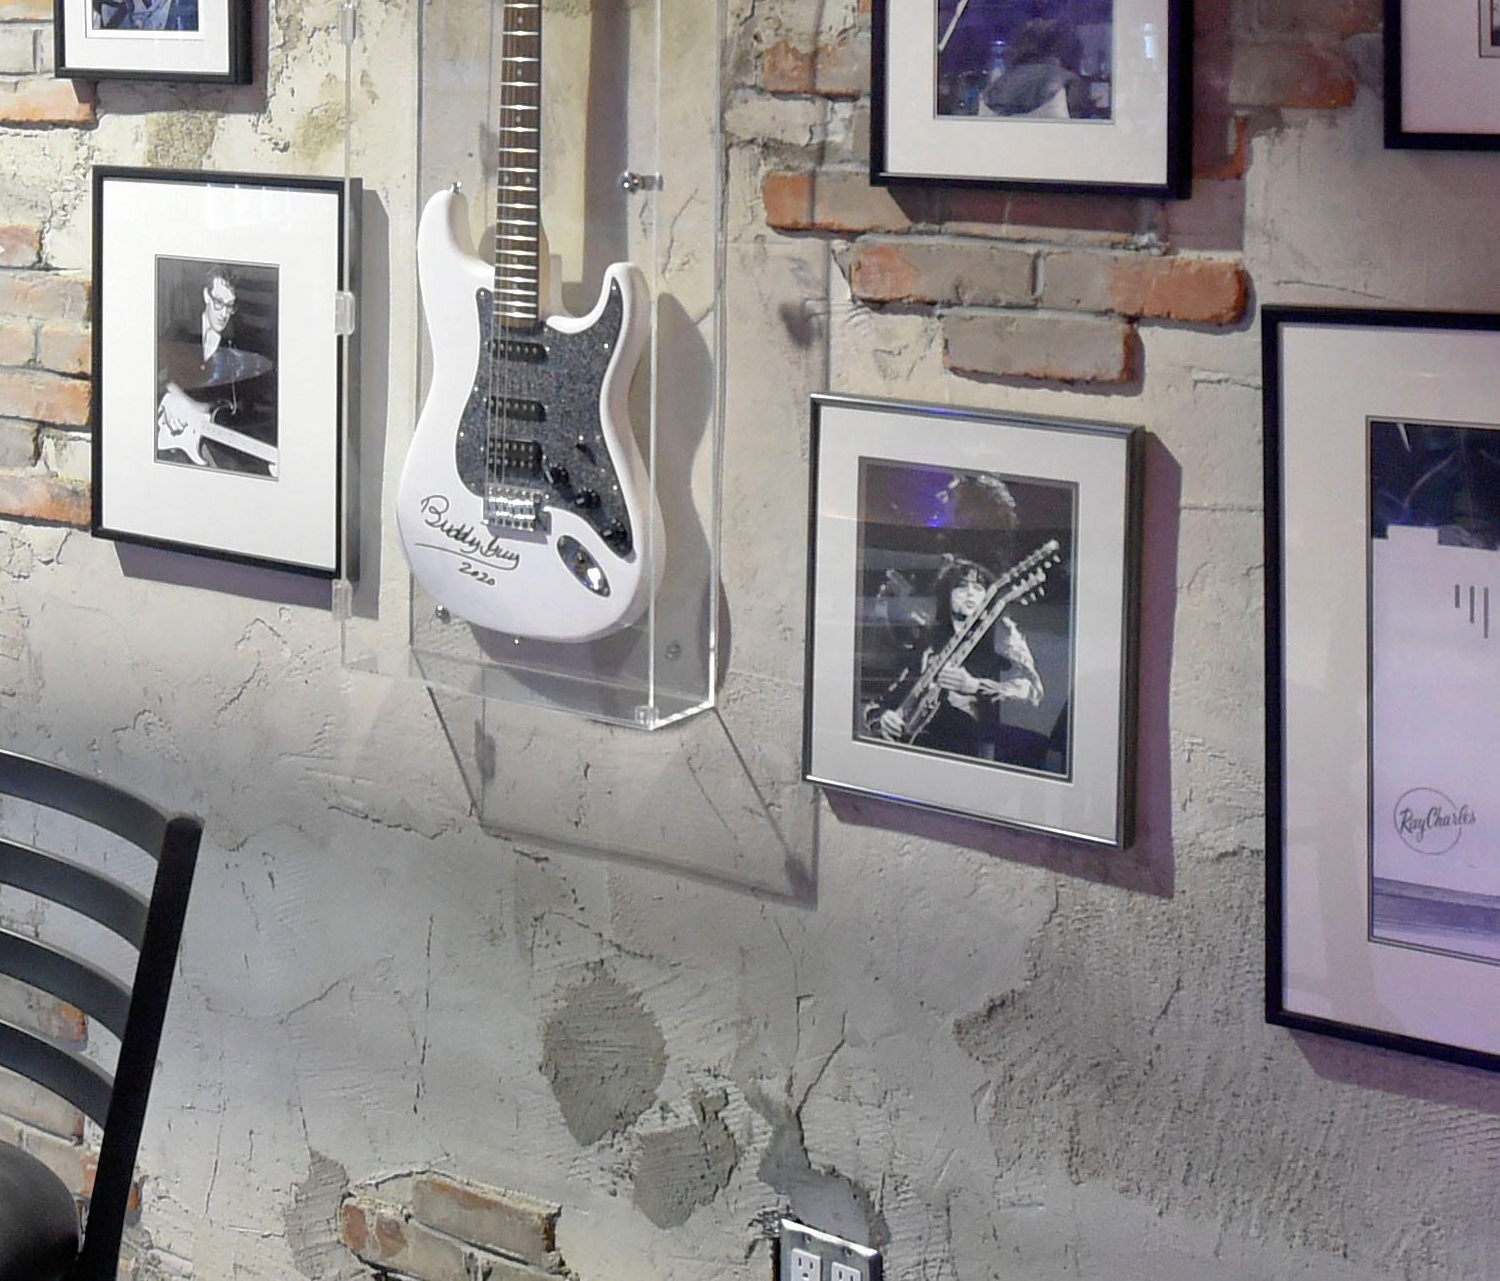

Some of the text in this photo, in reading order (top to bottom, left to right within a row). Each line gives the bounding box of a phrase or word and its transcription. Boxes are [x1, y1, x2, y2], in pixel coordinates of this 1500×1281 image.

[457, 562, 497, 586] 2020
[1399, 804, 1477, 843] Ray Charles
